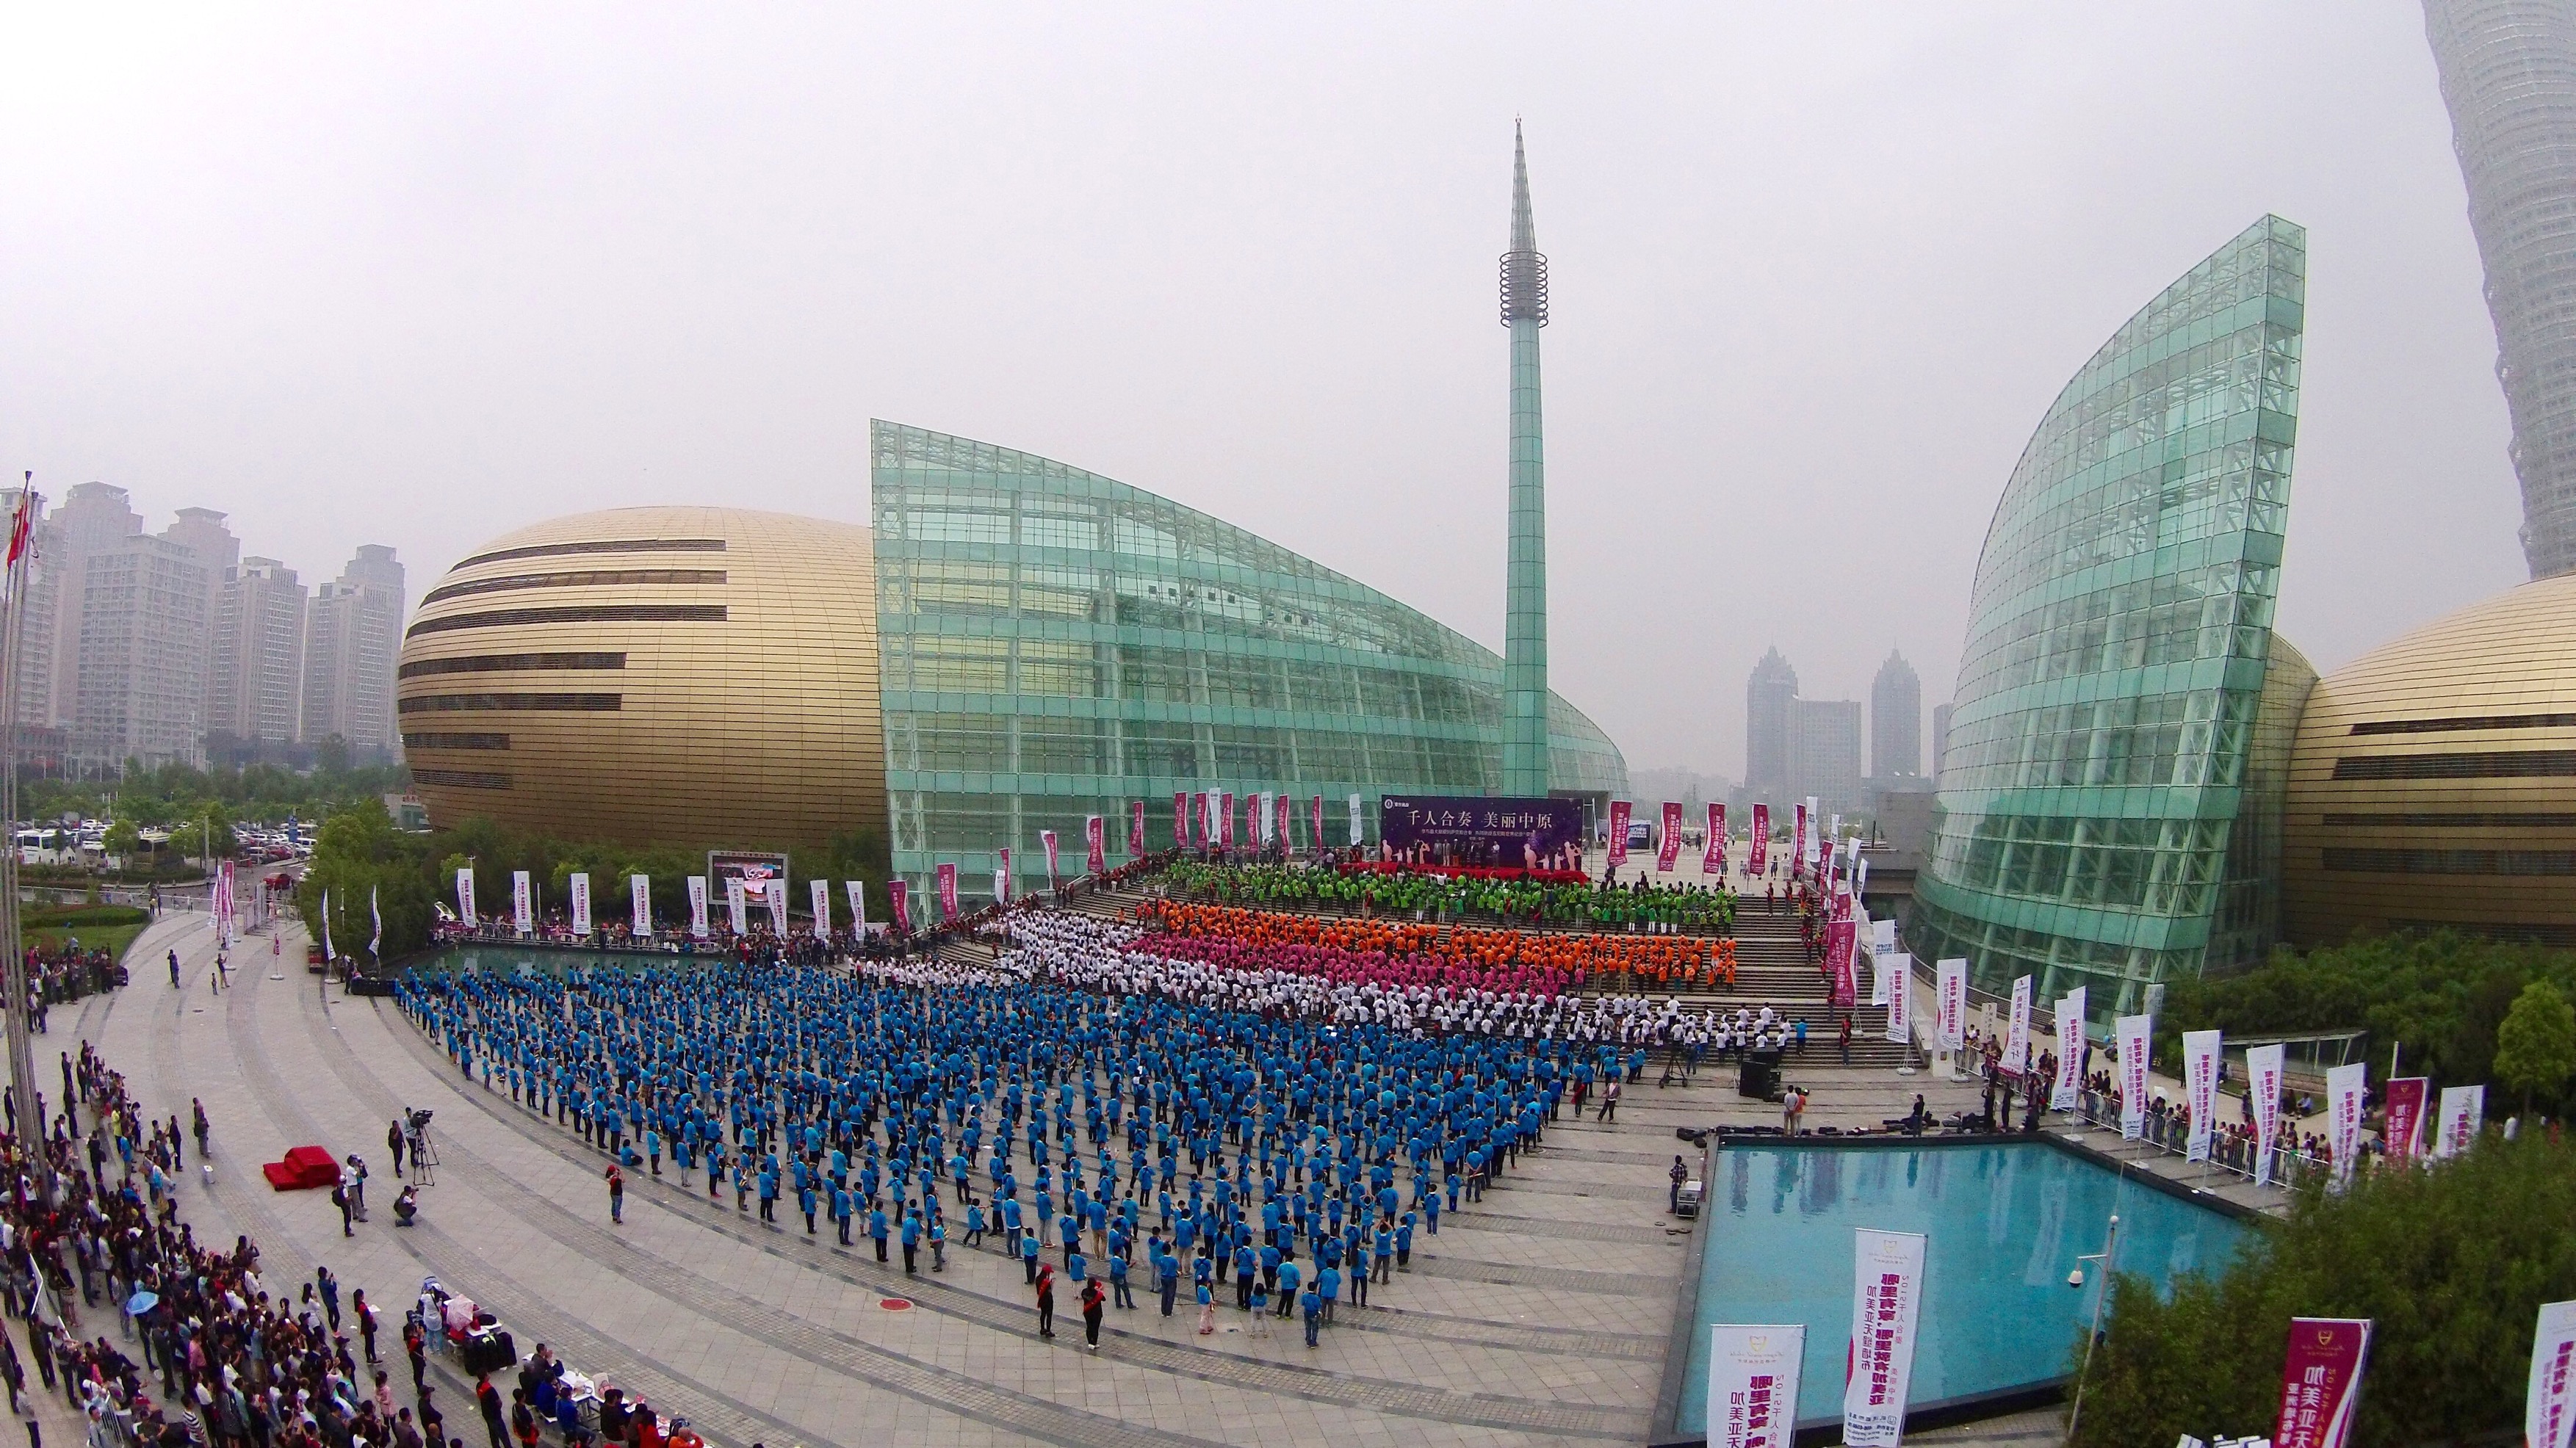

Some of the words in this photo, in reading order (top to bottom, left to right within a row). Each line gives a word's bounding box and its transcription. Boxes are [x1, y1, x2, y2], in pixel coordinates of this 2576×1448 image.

[1407, 810, 1472, 828] 千人合奏
[1483, 811, 1553, 829] 美丽中原
